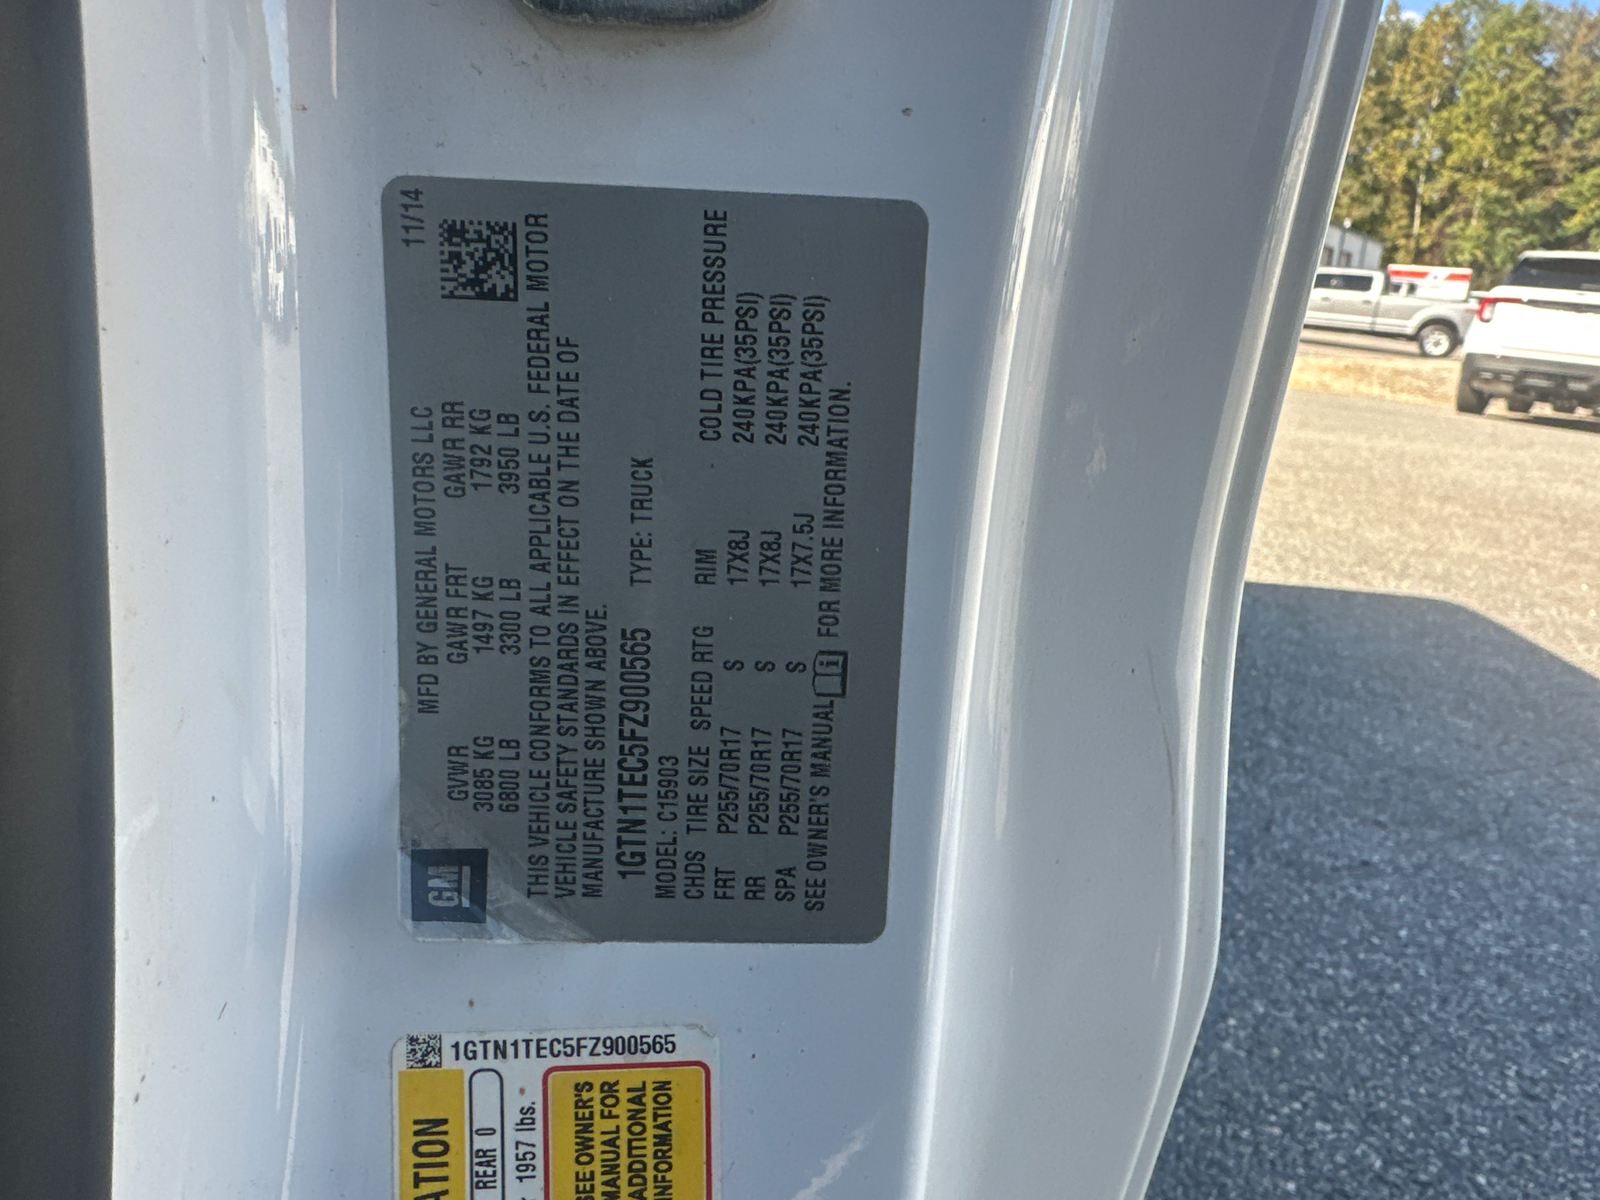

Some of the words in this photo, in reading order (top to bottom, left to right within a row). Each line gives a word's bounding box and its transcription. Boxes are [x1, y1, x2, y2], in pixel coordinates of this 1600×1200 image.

[400, 188, 424, 247] 11/14
[525, 214, 549, 291] MOTOR
[702, 210, 727, 324] PRESSURE
[526, 302, 550, 394] FEDERAL
[556, 337, 579, 363] OF
[700, 333, 724, 380] TIRE
[732, 292, 764, 443] 240KPA(35PSI)
[765, 294, 797, 445] 240KPA(35PSI)
[797, 296, 830, 446] 240KPA(35PSI)
[442, 401, 464, 429] RR
[557, 372, 579, 423] DATE
[699, 389, 722, 441] COLD
[410, 407, 434, 443] LLC
[469, 409, 491, 435] KG
[497, 413, 519, 437] LB
[528, 405, 550, 444] U.S.
[442, 438, 466, 498] GAWR
[469, 444, 492, 491] 1792
[497, 447, 520, 494] 3950
[557, 432, 579, 471] THE
[822, 382, 851, 529] INFORMATION.
[412, 452, 436, 536] MOTORS
[528, 454, 551, 574] APPLICABLE
[557, 480, 579, 507] ON
[630, 457, 653, 524] TRUCK
[557, 515, 579, 586] EFFECT
[630, 532, 652, 586] TYPE:
[695, 549, 717, 584] RIM
[727, 530, 750, 585] 17X8J
[759, 531, 782, 586] 17X8J
[790, 513, 814, 587] 17X7.5J
[819, 537, 843, 592] MORE
[415, 546, 438, 633] GENERAL
[445, 563, 467, 598] FRT
[472, 577, 493, 601] KG
[499, 579, 521, 601] LB
[529, 582, 551, 617] ALL
[557, 595, 579, 614] IN
[817, 600, 840, 637] FOR
[416, 641, 438, 665] BY
[446, 607, 468, 664] GAWR
[472, 610, 494, 654] 1497
[499, 611, 521, 655] 3300
[529, 625, 551, 649] TO
[585, 605, 607, 671] ABOVE.
[692, 626, 713, 662] RTG
[557, 622, 579, 737] STANDARDS
[723, 660, 744, 671] S
[754, 661, 775, 672] S
[786, 662, 807, 673] S
[417, 674, 439, 713] MFD
[529, 656, 551, 761] CONFORMS
[584, 680, 606, 750] SHOWN
[690, 671, 713, 730] SPEED
[473, 736, 494, 759] KG
[499, 739, 520, 760] LB
[615, 628, 651, 879] 1GTN1TEC5FZ900565
[810, 700, 834, 777] MANUAL
[447, 746, 469, 801] GVWR
[556, 744, 578, 813] SAFETY
[657, 756, 679, 821] C15903
[688, 746, 709, 786] SIZE
[717, 726, 741, 834] P255/70R17
[748, 727, 772, 834] P255/70R17
[778, 728, 802, 835] P255/70R17
[473, 769, 494, 812] 3085
[498, 770, 519, 813] 6800
[528, 770, 550, 847] VEHICLE
[686, 793, 708, 834] TIRE
[582, 758, 605, 897] MANUFACTURE
[806, 786, 830, 871] OWNER'S
[527, 854, 549, 898] THIS
[555, 821, 577, 898] VEHICLE
[655, 831, 677, 898] MODEL:
[683, 851, 705, 899] CHDS
[714, 867, 735, 899] FRT
[428, 867, 459, 907] GM
[744, 876, 765, 900] RR
[775, 867, 796, 901] SPA
[804, 879, 826, 911] SEE
[451, 1034, 676, 1061] 1GTN1TEC5FZ900565
[515, 1102, 535, 1131] lbs.
[574, 1081, 594, 1165] OWNER'S
[600, 1080, 620, 1119] FOR
[515, 1141, 536, 1183] 1957
[627, 1081, 647, 1200] ADDITIONAL
[475, 1149, 496, 1189] REAR
